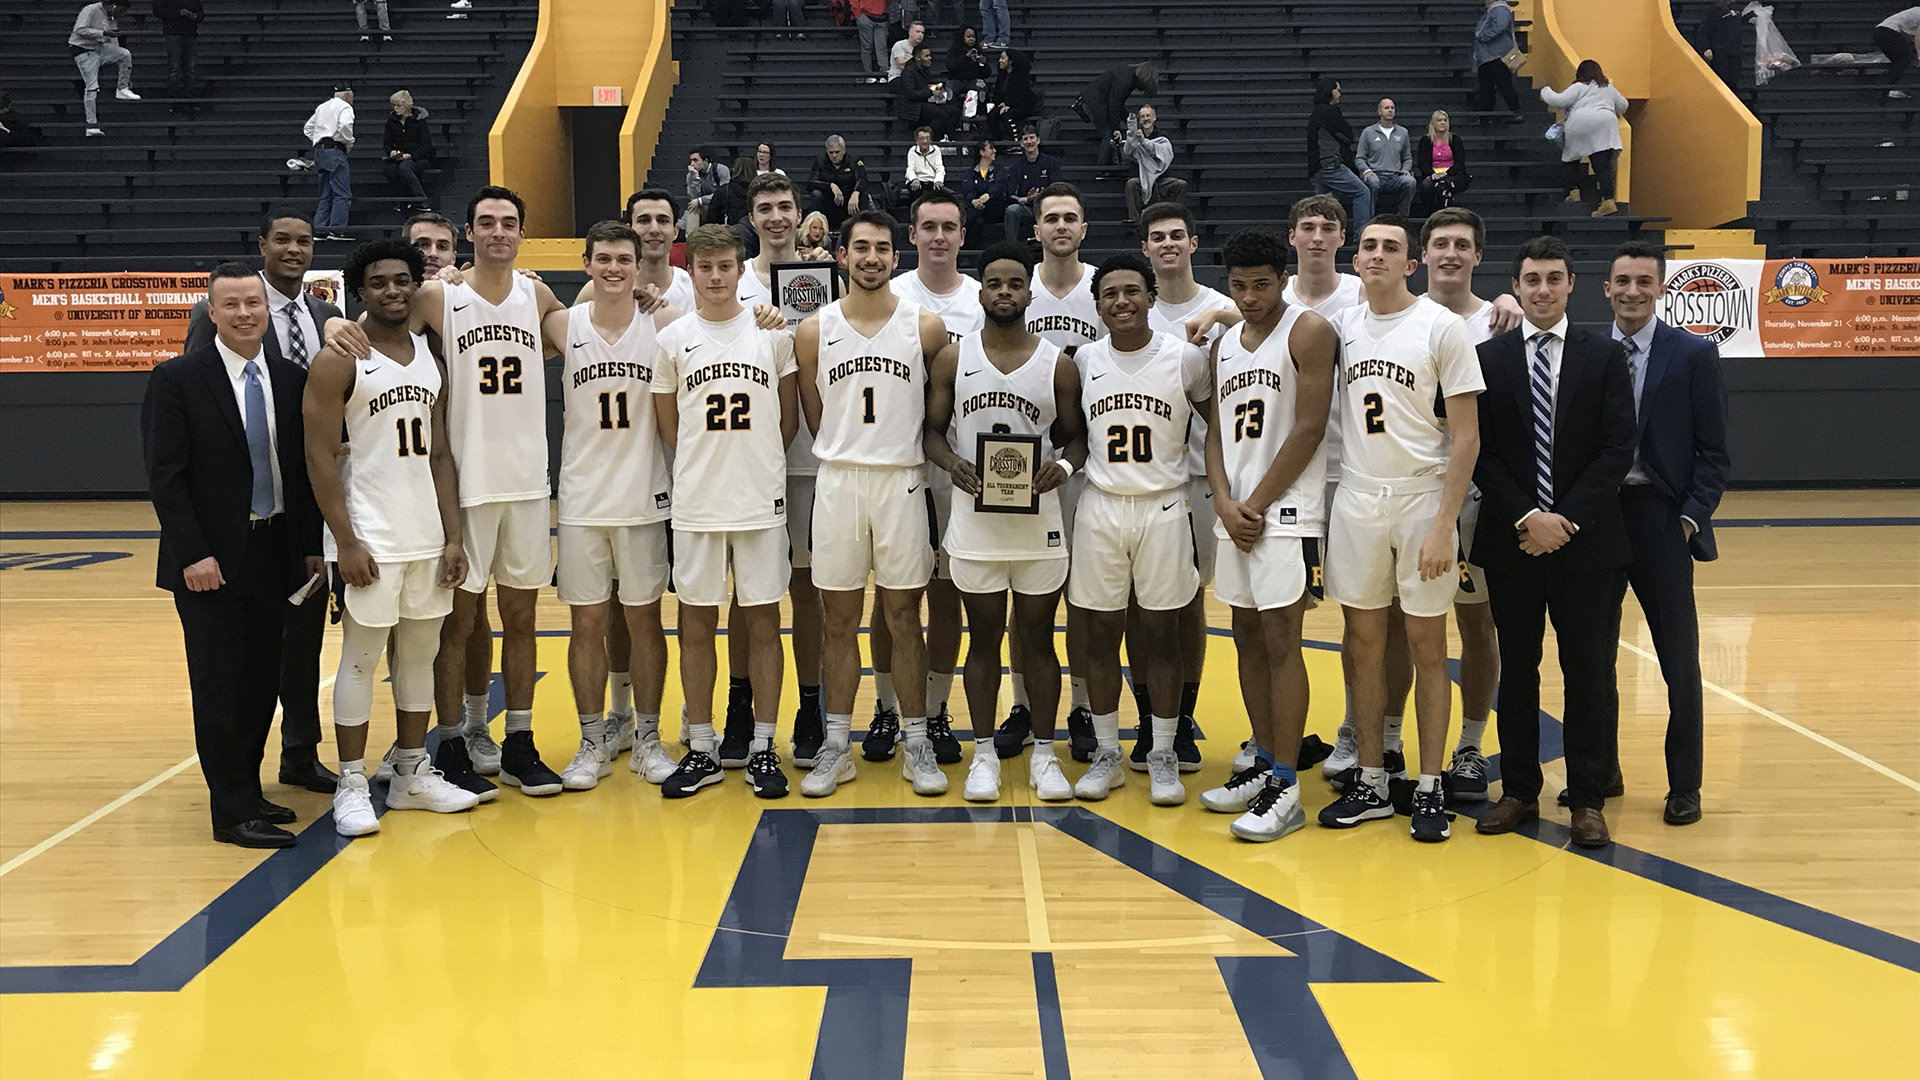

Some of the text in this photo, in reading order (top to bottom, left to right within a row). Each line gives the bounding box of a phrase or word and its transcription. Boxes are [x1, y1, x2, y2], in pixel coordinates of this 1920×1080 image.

[598, 88, 617, 103] EXIT
[1671, 266, 1736, 290] MARK'S PIZZERIA
[1830, 264, 1870, 274] MARK'S
[13, 277, 208, 290] MARK'S PIZZERIA CROSSTOWN SHOO
[783, 284, 828, 306] CROSSTOWN
[1846, 278, 1920, 290] MEN'S BASKE
[32, 294, 68, 306] MEN'S
[70, 293, 142, 305] BASKETBALL
[1665, 287, 1753, 330] ROSSTOWN
[1866, 295, 1920, 305] @ UNIVERS
[54, 311, 64, 320] @
[68, 310, 125, 320] UNIVERSITY
[128, 310, 141, 320] OF
[1764, 320, 1796, 328] Thursday,
[114, 329, 138, 338] College
[130, 338, 154, 346] College
[457, 324, 536, 354] ROCHESTER
[1028, 316, 1097, 342] OCHESTER
[1764, 341, 1795, 350] Saturday,
[478, 356, 522, 395] 32
[573, 362, 653, 389] ROCHESTER
[686, 362, 770, 392] ROCHESTER
[828, 356, 911, 386] ROCHESTER
[1346, 359, 1415, 391] OCHESTER
[369, 385, 437, 416] ROCHESTE
[598, 391, 630, 429] 11
[706, 392, 752, 432] 22
[862, 386, 876, 424] 1
[963, 392, 1040, 424] ROCHESTER
[1090, 393, 1172, 421] ROCHESTER
[1364, 392, 1386, 435] 2
[396, 417, 428, 458] 10
[1107, 424, 1153, 464] 20
[990, 456, 1028, 474] CROSSTOWN
